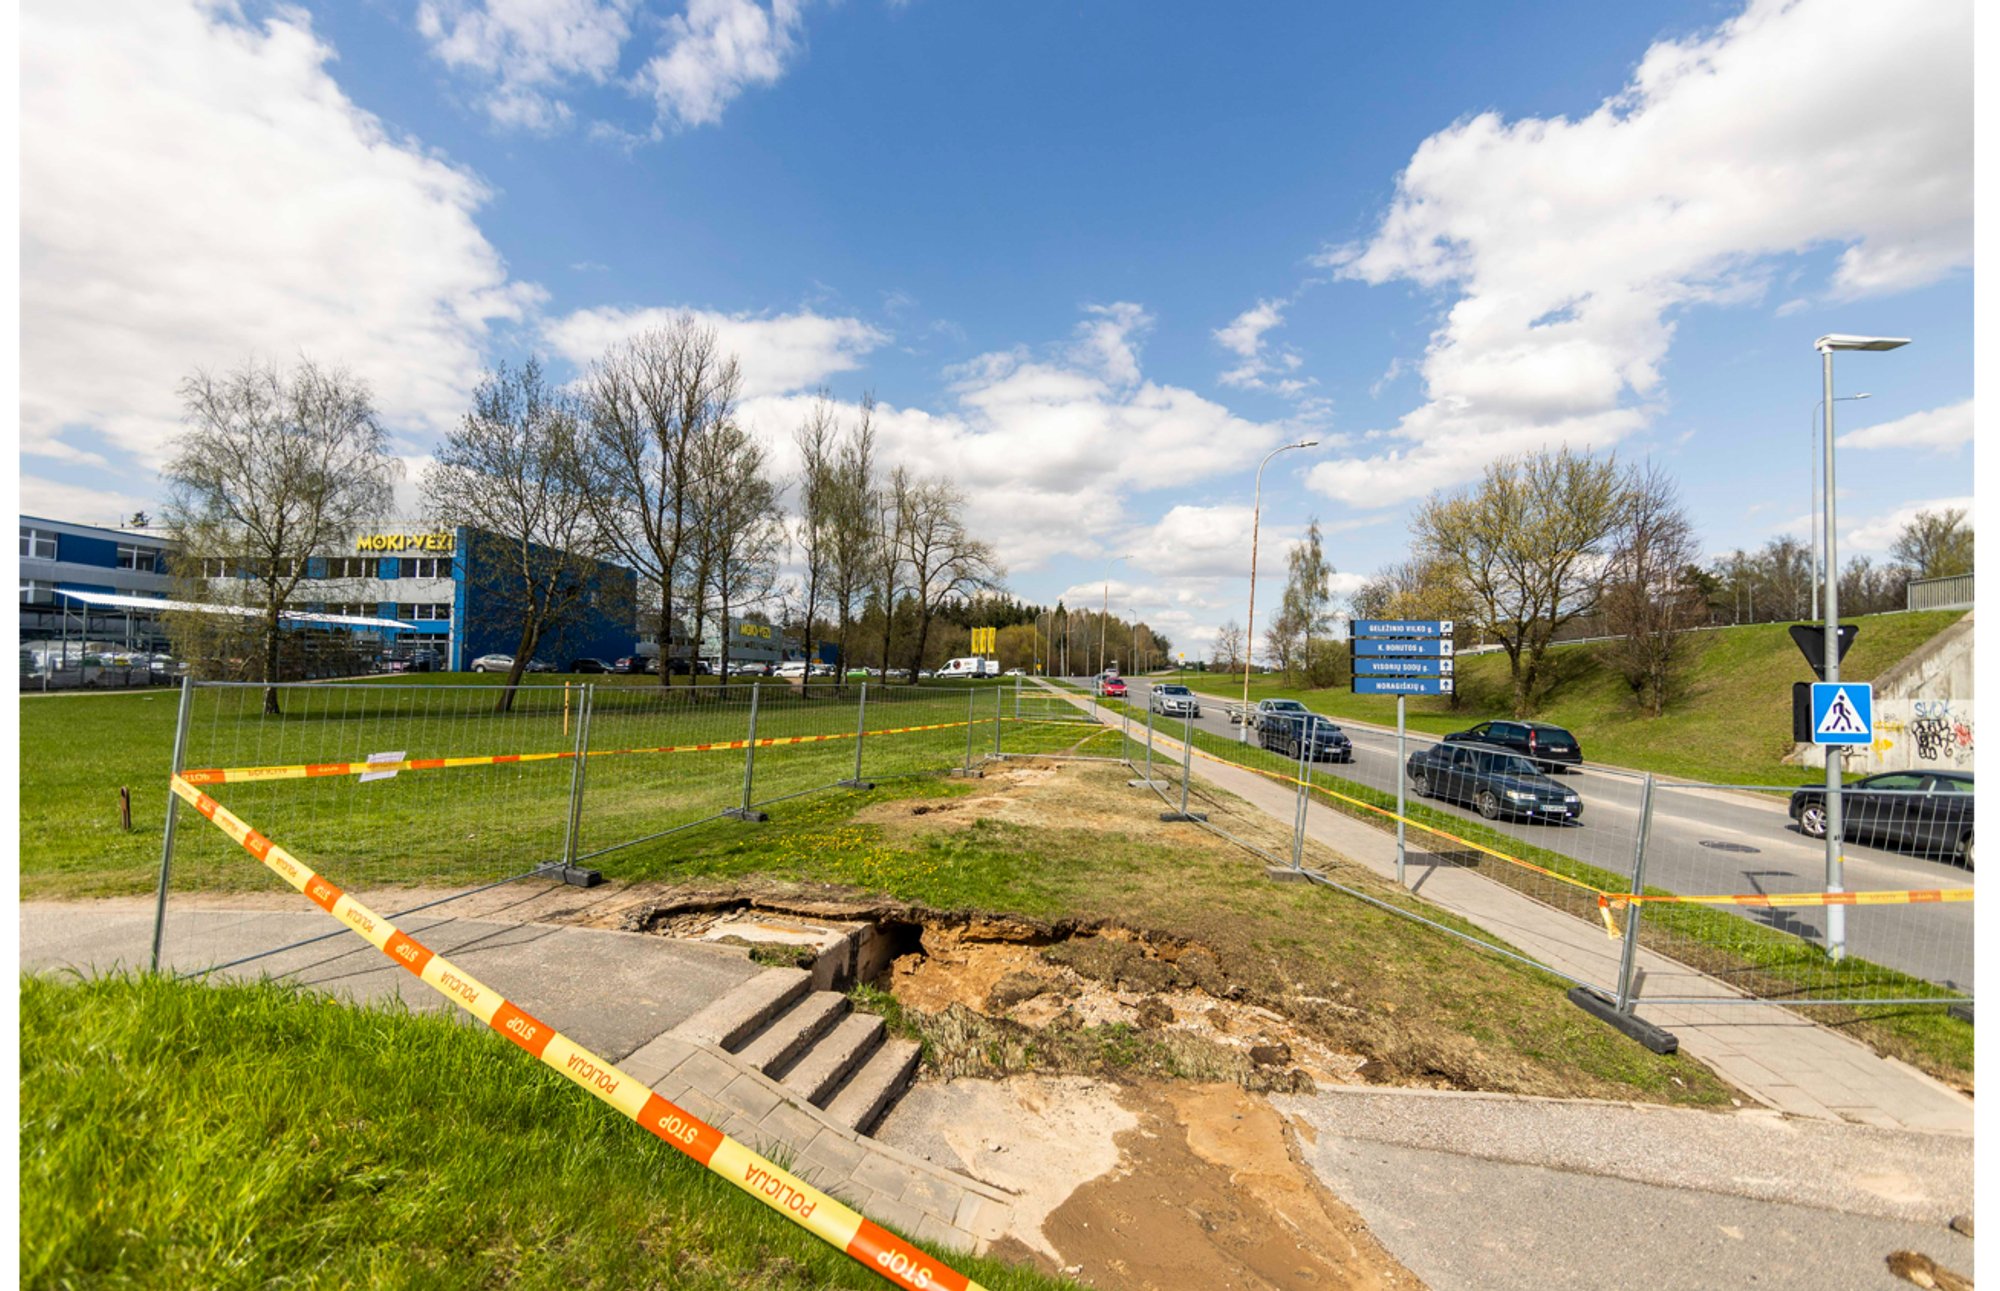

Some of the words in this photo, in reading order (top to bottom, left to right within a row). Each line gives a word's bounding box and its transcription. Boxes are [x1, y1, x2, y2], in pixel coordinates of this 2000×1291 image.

[357, 533, 405, 551] MOKI
[1369, 624, 1404, 632] GELEŽINIO
[1373, 663, 1401, 671] VISORIŲ
[1403, 663, 1421, 672] SODŲ
[346, 907, 377, 933] POLICIJA
[395, 942, 419, 962] STOP
[441, 971, 480, 1004] POLICIJA
[505, 1016, 537, 1041] STOP
[567, 1053, 620, 1095] POLICIJA
[658, 1114, 699, 1145] STOP
[744, 1162, 818, 1219] POLICIJA
[877, 1248, 933, 1289] STOP
